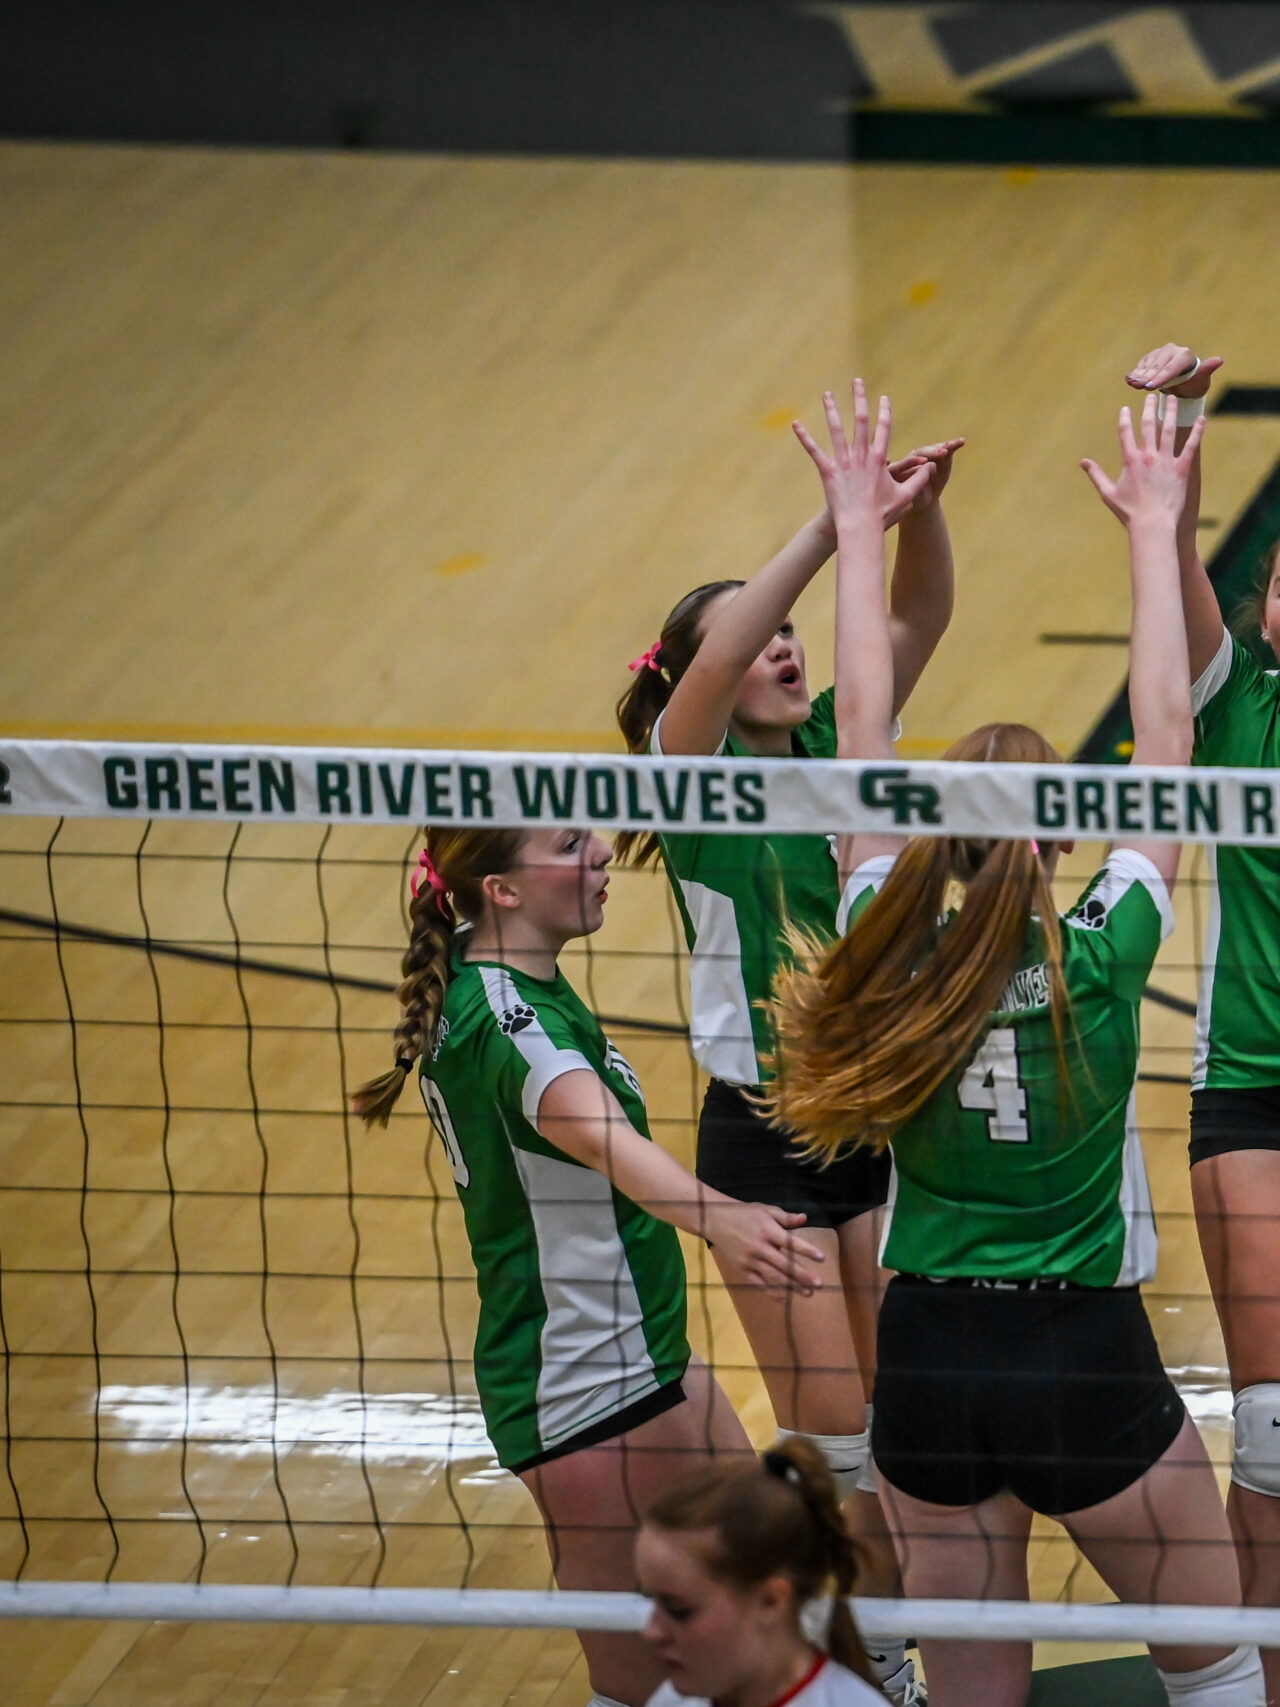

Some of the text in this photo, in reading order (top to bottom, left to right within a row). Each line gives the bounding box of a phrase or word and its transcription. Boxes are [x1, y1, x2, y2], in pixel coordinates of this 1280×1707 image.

[101, 755, 297, 816] GREEN
[315, 760, 494, 820] RIVER
[511, 763, 767, 825] WOLVES
[1033, 777, 1221, 835] GREEN
[957, 1027, 1031, 1145] 4
